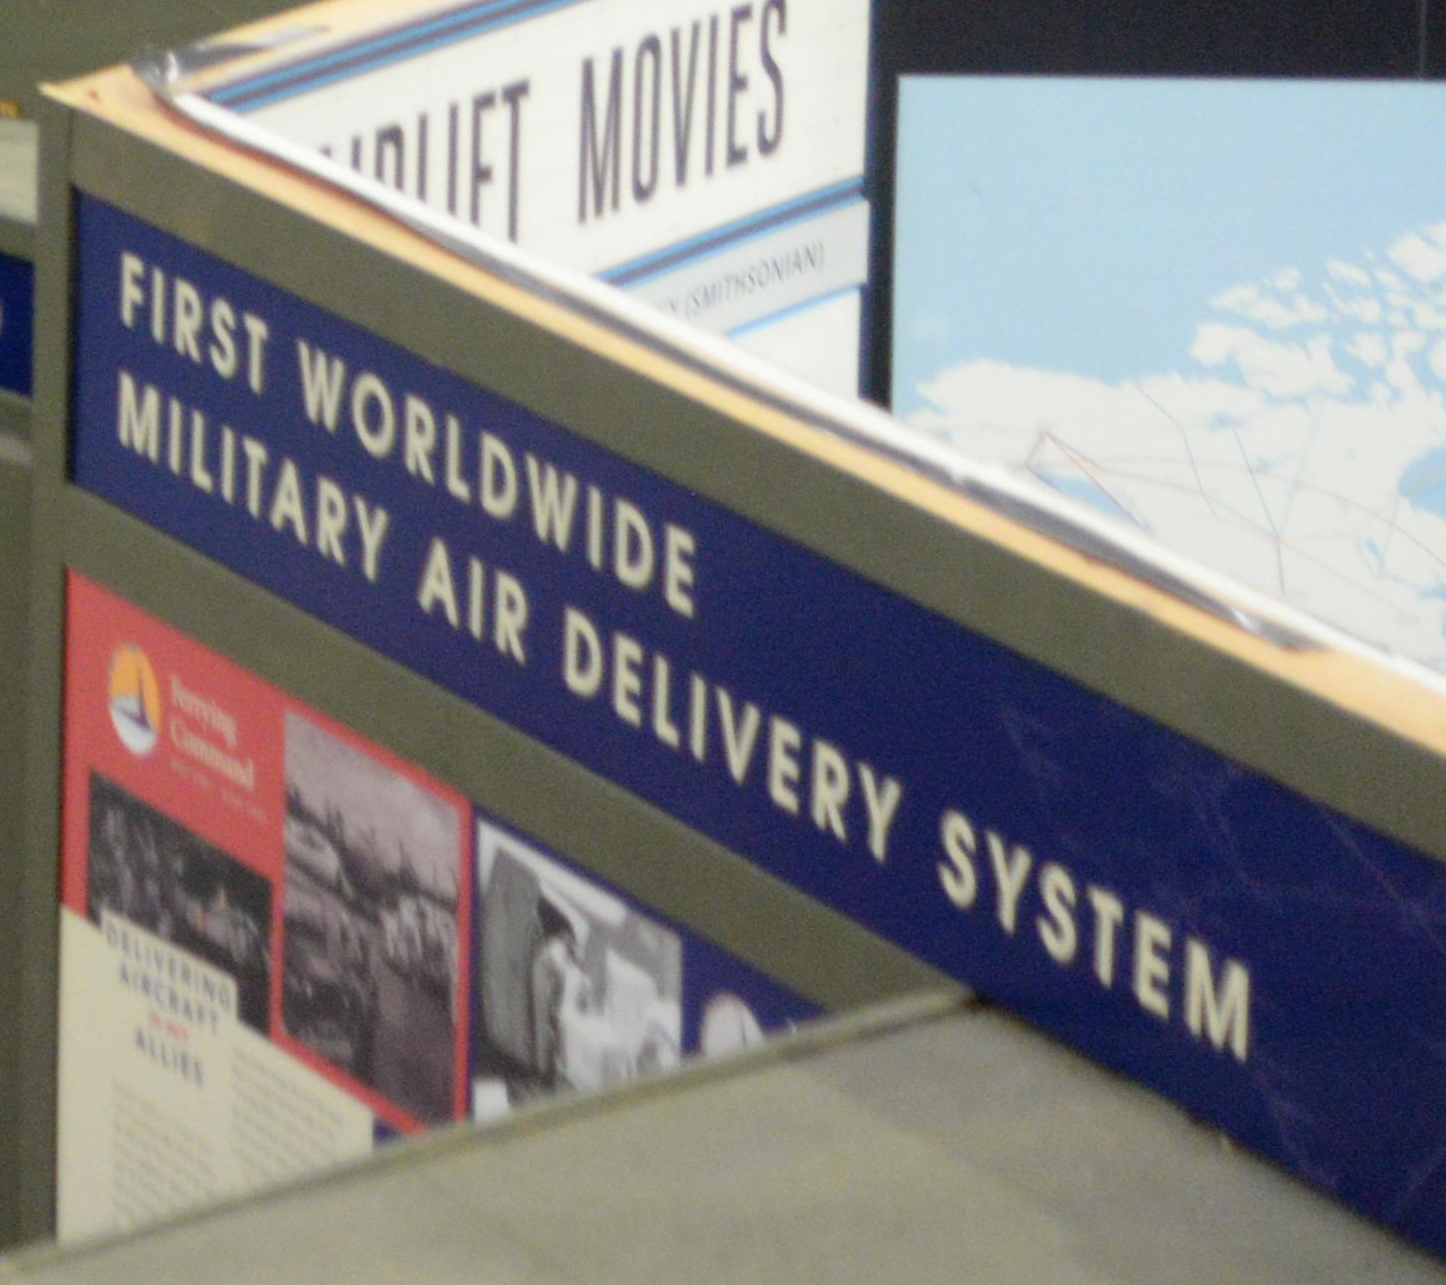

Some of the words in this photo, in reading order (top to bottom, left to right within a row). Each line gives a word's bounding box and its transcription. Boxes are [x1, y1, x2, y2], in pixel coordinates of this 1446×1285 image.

[686, 241, 825, 318] (SMITHSONIAN)
[118, 251, 270, 396] FIRST
[298, 340, 698, 621] WORLDWIDE
[115, 371, 390, 586] MILITARY
[418, 537, 530, 666] AIR
[563, 607, 904, 866] DELIVERY
[936, 810, 1256, 1062] SYSTEM
[170, 717, 255, 792] Command
[105, 919, 232, 1013] DELIVERING
[119, 962, 218, 1033] AIRCRAFT
[135, 1027, 203, 1088] ALLIES
